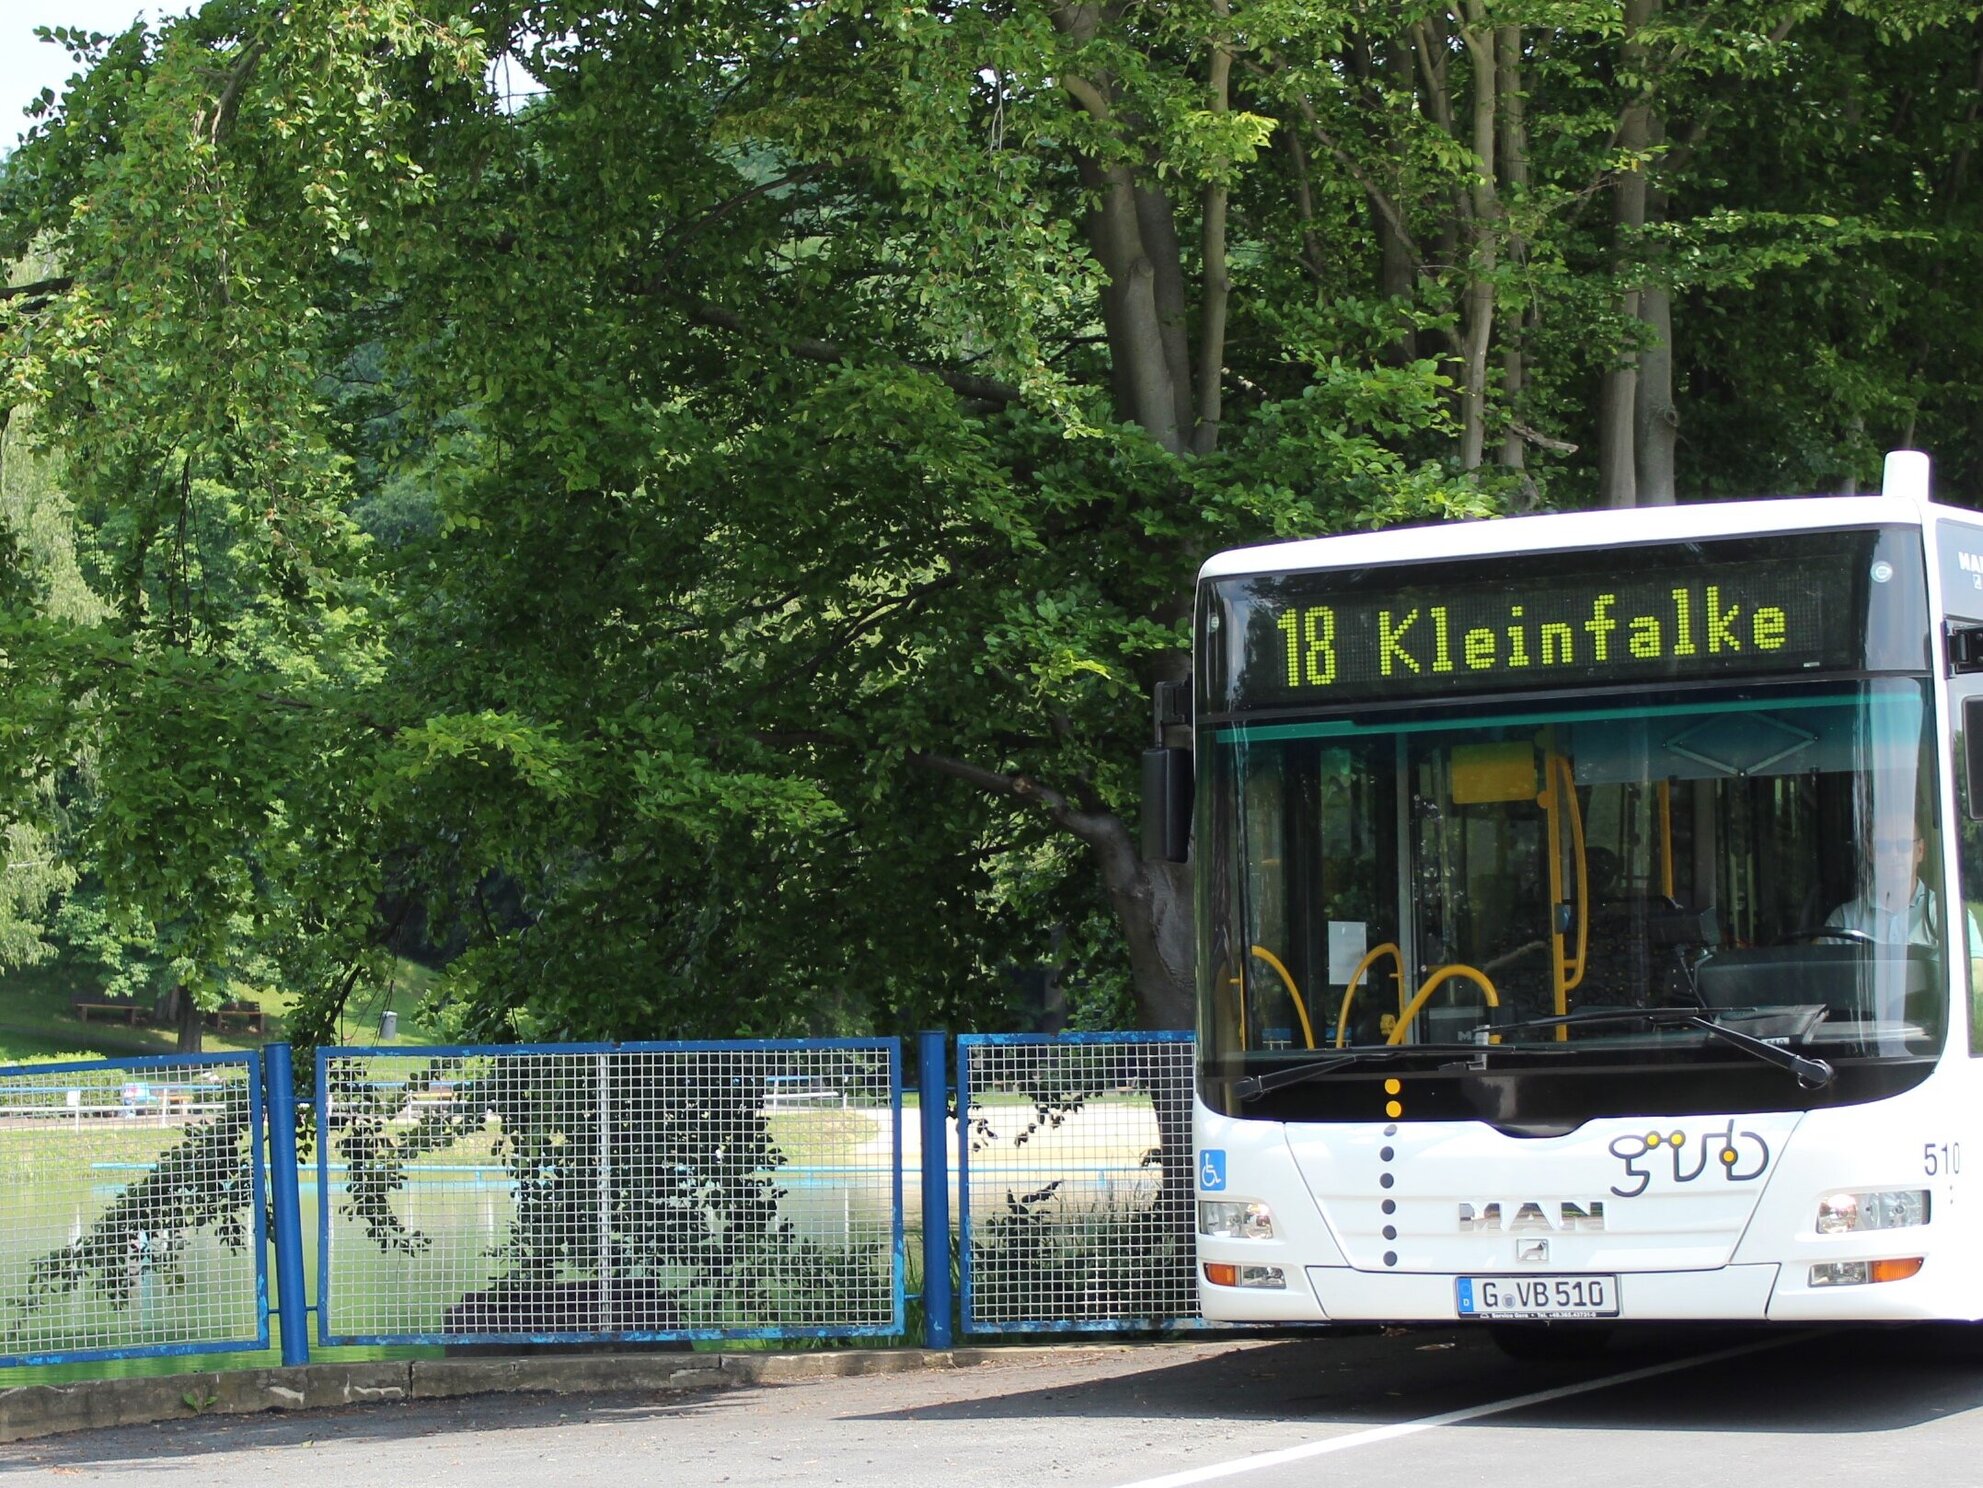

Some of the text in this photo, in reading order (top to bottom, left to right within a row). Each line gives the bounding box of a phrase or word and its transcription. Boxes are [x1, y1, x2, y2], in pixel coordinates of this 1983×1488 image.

[1277, 585, 1786, 687] 18 Kleinfalke
[1924, 1142, 1960, 1177] 510
[1458, 1202, 1606, 1232] MAN
[1463, 1299, 1470, 1307] D
[1483, 1281, 1604, 1308] G VB 510
